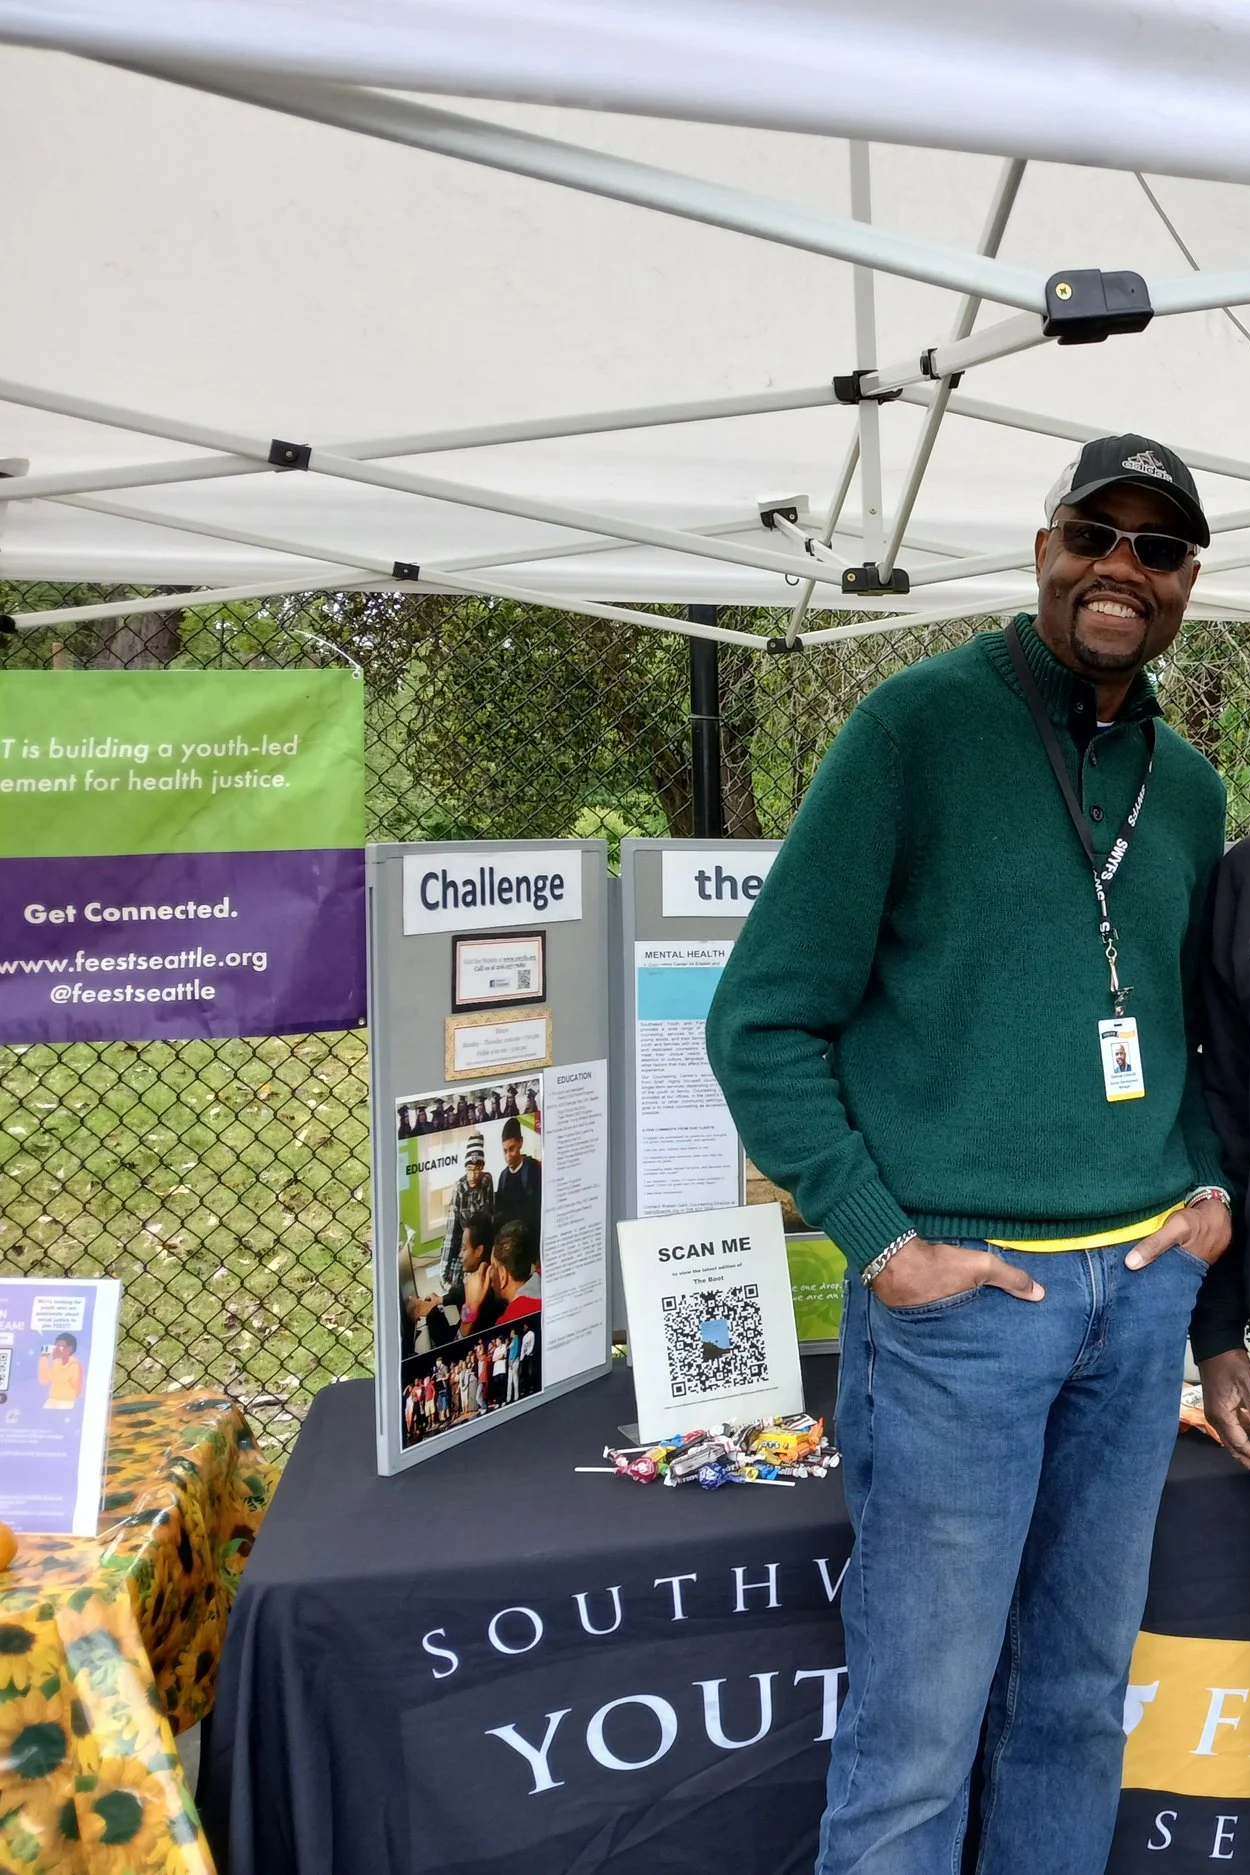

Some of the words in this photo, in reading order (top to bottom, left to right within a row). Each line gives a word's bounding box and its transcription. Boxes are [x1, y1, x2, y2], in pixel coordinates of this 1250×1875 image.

[1122, 460, 1173, 482] adidas
[23, 739, 40, 759] is
[49, 737, 149, 764] building
[158, 745, 173, 758] a
[182, 734, 299, 762] youth-led
[84, 770, 119, 792] for
[128, 769, 203, 791] health
[211, 768, 291, 794] justice.
[1101, 838, 1128, 881] SWYFS
[420, 866, 565, 911] Challenge
[694, 865, 764, 900] the
[24, 903, 76, 924] Get
[84, 897, 238, 922] Connected.
[0, 946, 268, 974] www.feestseattle.org
[645, 951, 684, 959] MENTAL
[687, 950, 725, 958] HEALTH
[50, 979, 216, 1005] @feestseattle
[557, 1072, 592, 1085] EDUCATION
[405, 1154, 459, 1176] EDUCATION
[658, 1241, 715, 1262] SCAN
[721, 1236, 751, 1254] ME
[708, 1275, 724, 1283] Boot
